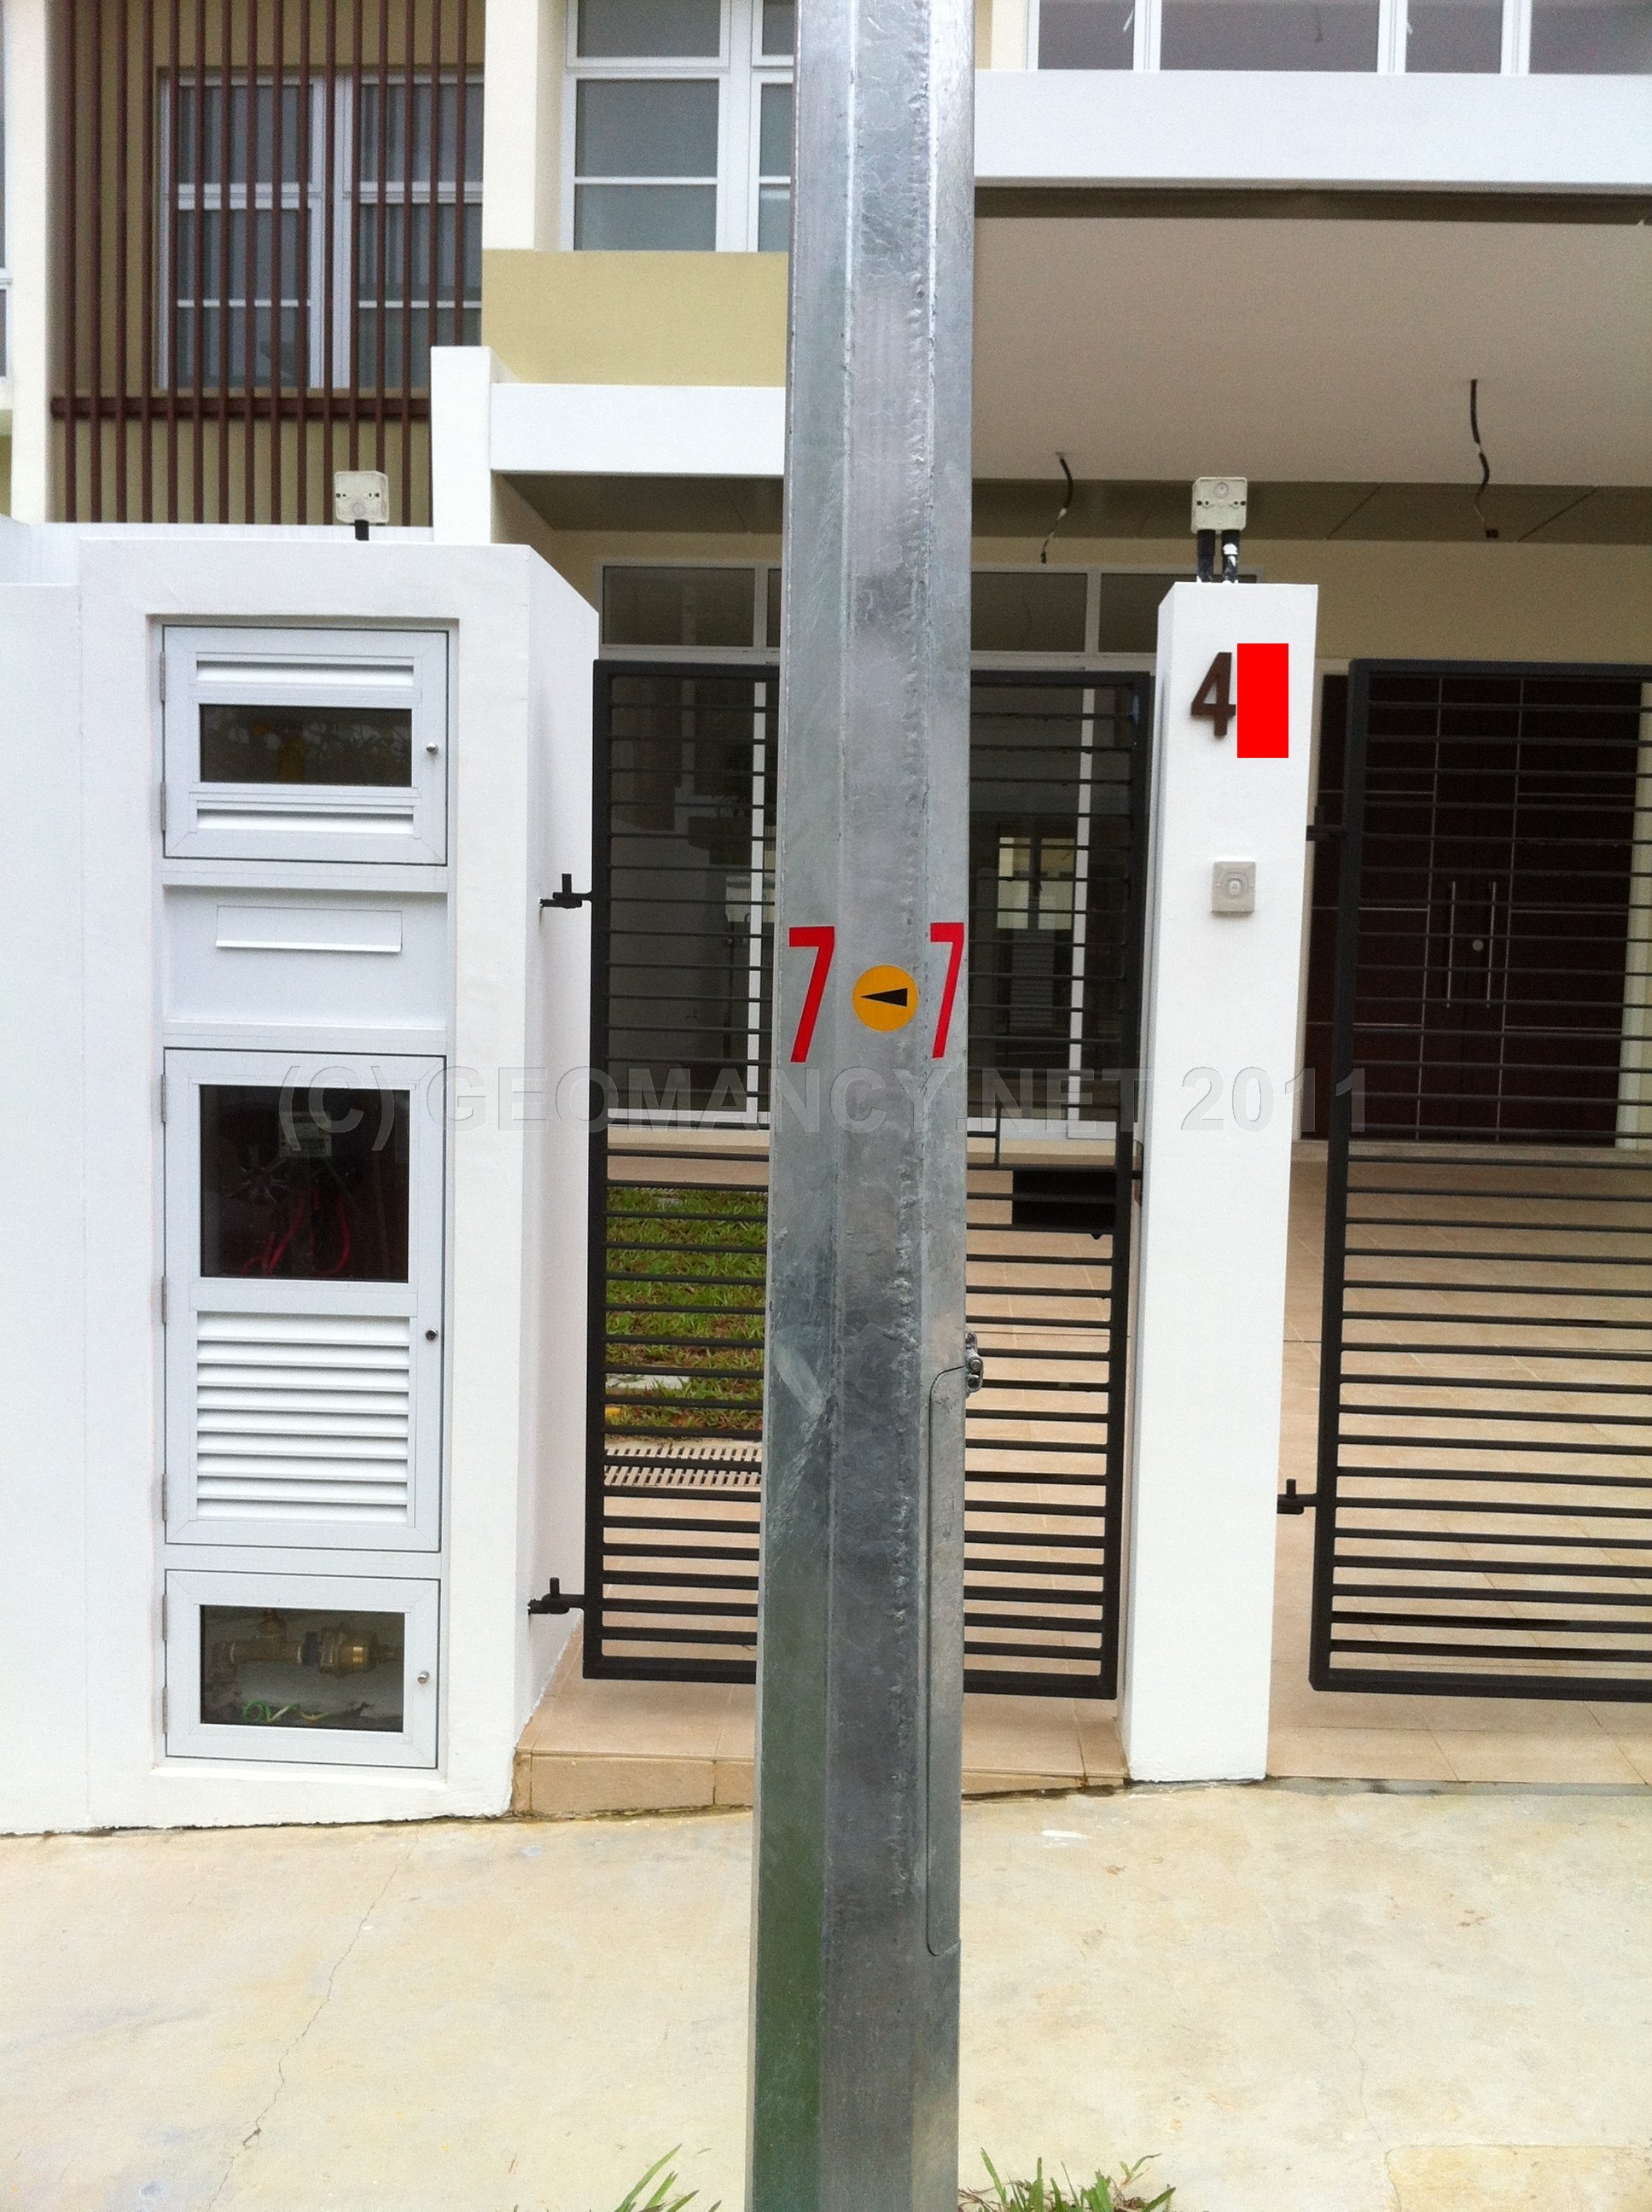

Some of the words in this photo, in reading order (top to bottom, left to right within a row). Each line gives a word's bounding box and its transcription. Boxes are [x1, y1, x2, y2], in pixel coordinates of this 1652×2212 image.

[1190, 652, 1236, 736] 4
[789, 926, 835, 1062] 7
[930, 923, 964, 1058] 7
